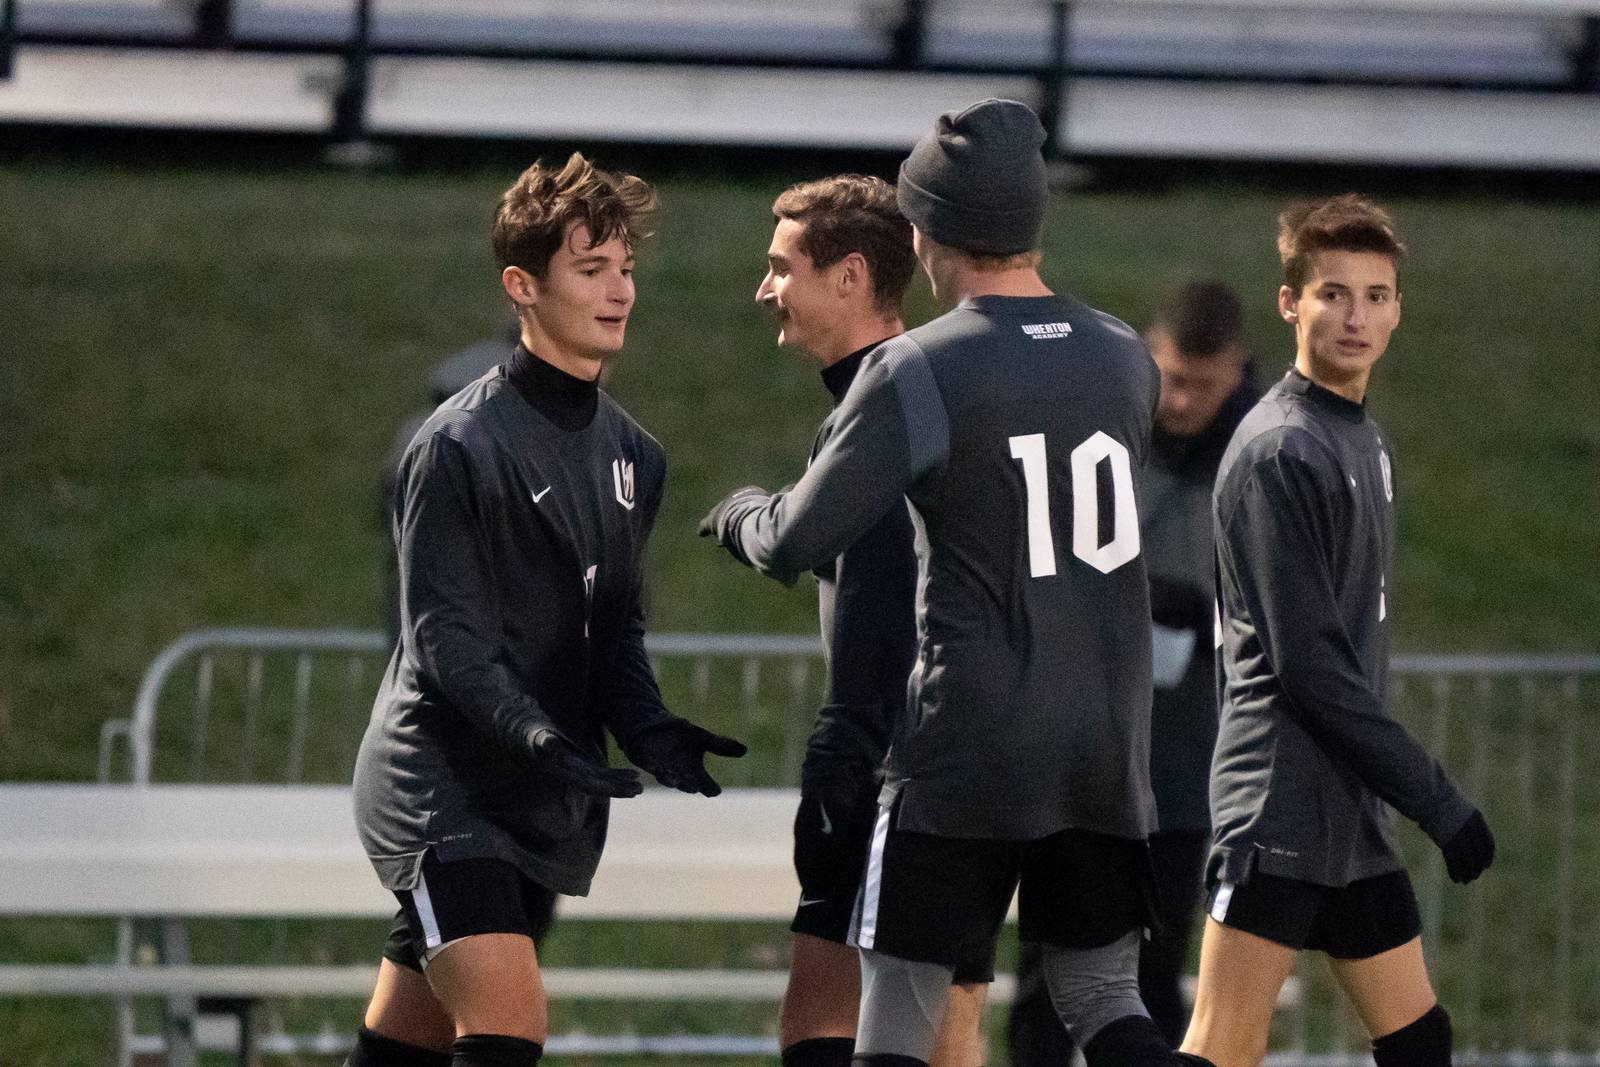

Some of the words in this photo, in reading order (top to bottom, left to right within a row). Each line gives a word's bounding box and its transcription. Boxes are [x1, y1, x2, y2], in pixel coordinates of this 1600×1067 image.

[1021, 322, 1073, 335] WHEATON
[1032, 332, 1069, 340] ACADEMY
[1008, 430, 1141, 578] 10
